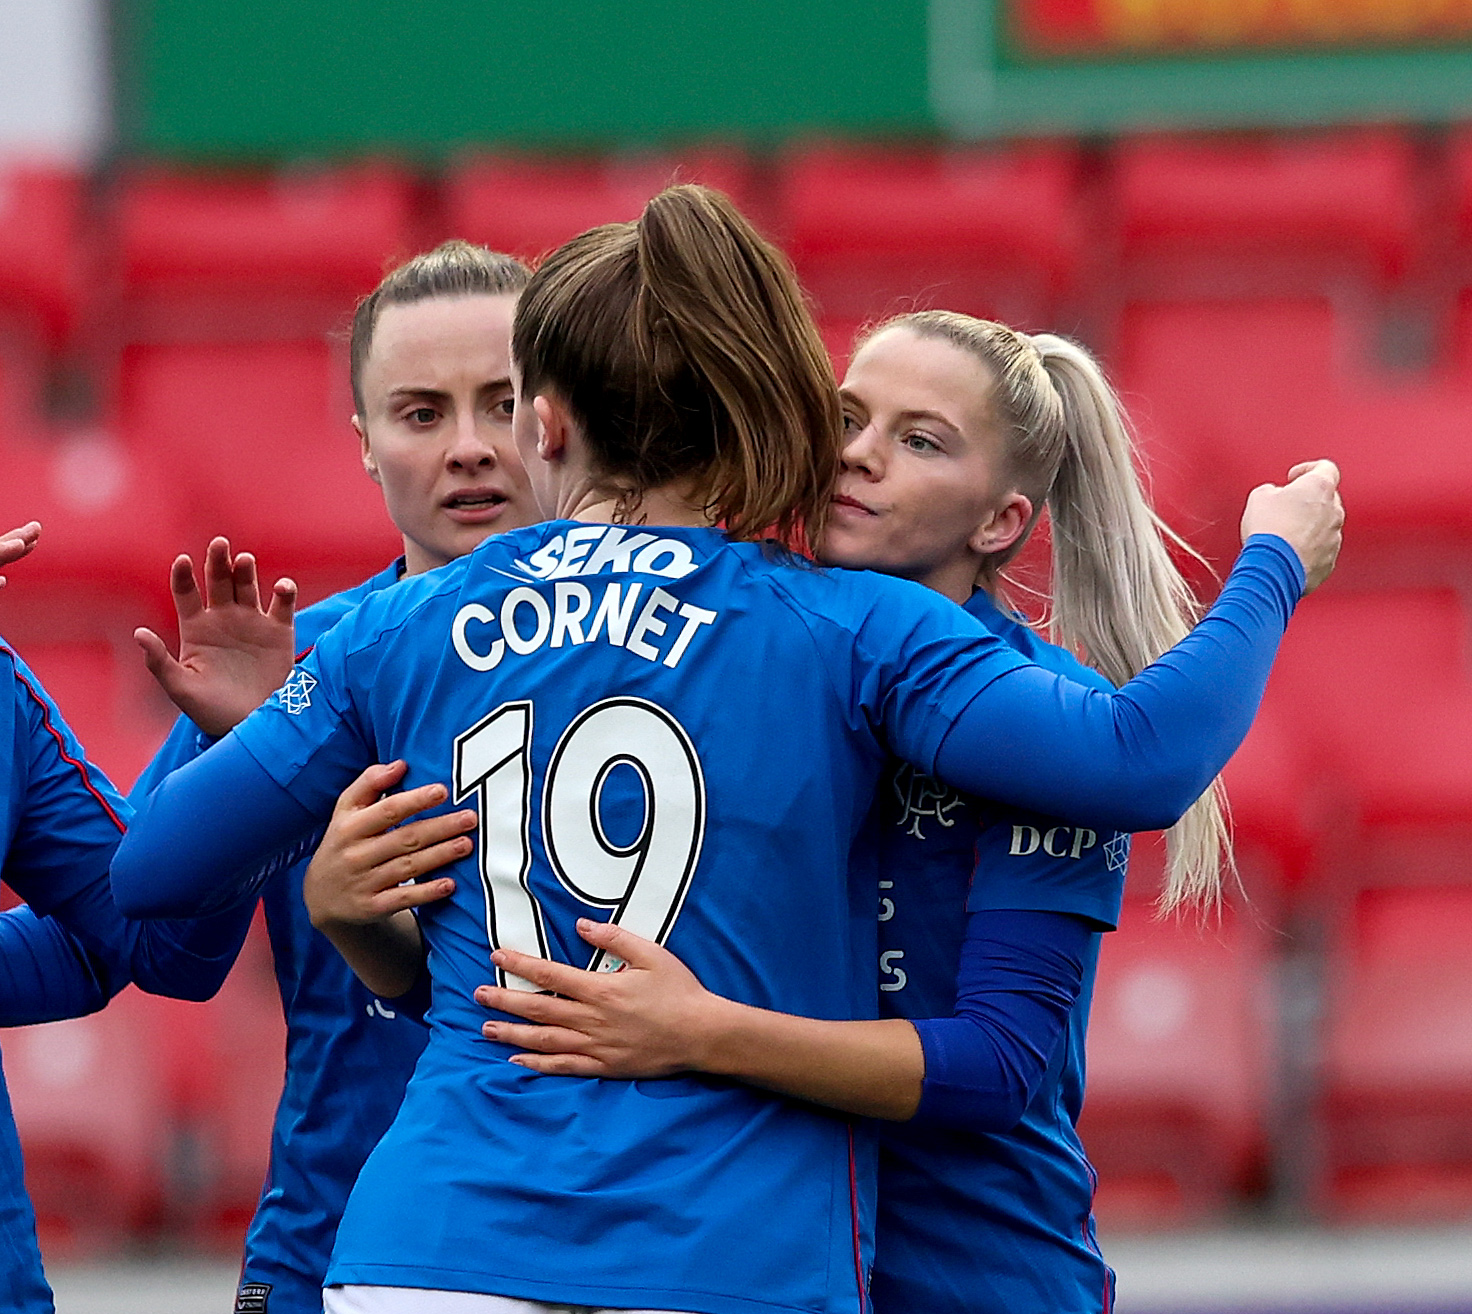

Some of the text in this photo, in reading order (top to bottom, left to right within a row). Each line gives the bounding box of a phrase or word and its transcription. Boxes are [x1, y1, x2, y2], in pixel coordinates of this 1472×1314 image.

[512, 526, 699, 581] SEKO
[452, 582, 717, 671] CORNET
[453, 696, 705, 998] 19
[1008, 824, 1097, 859] DCP
